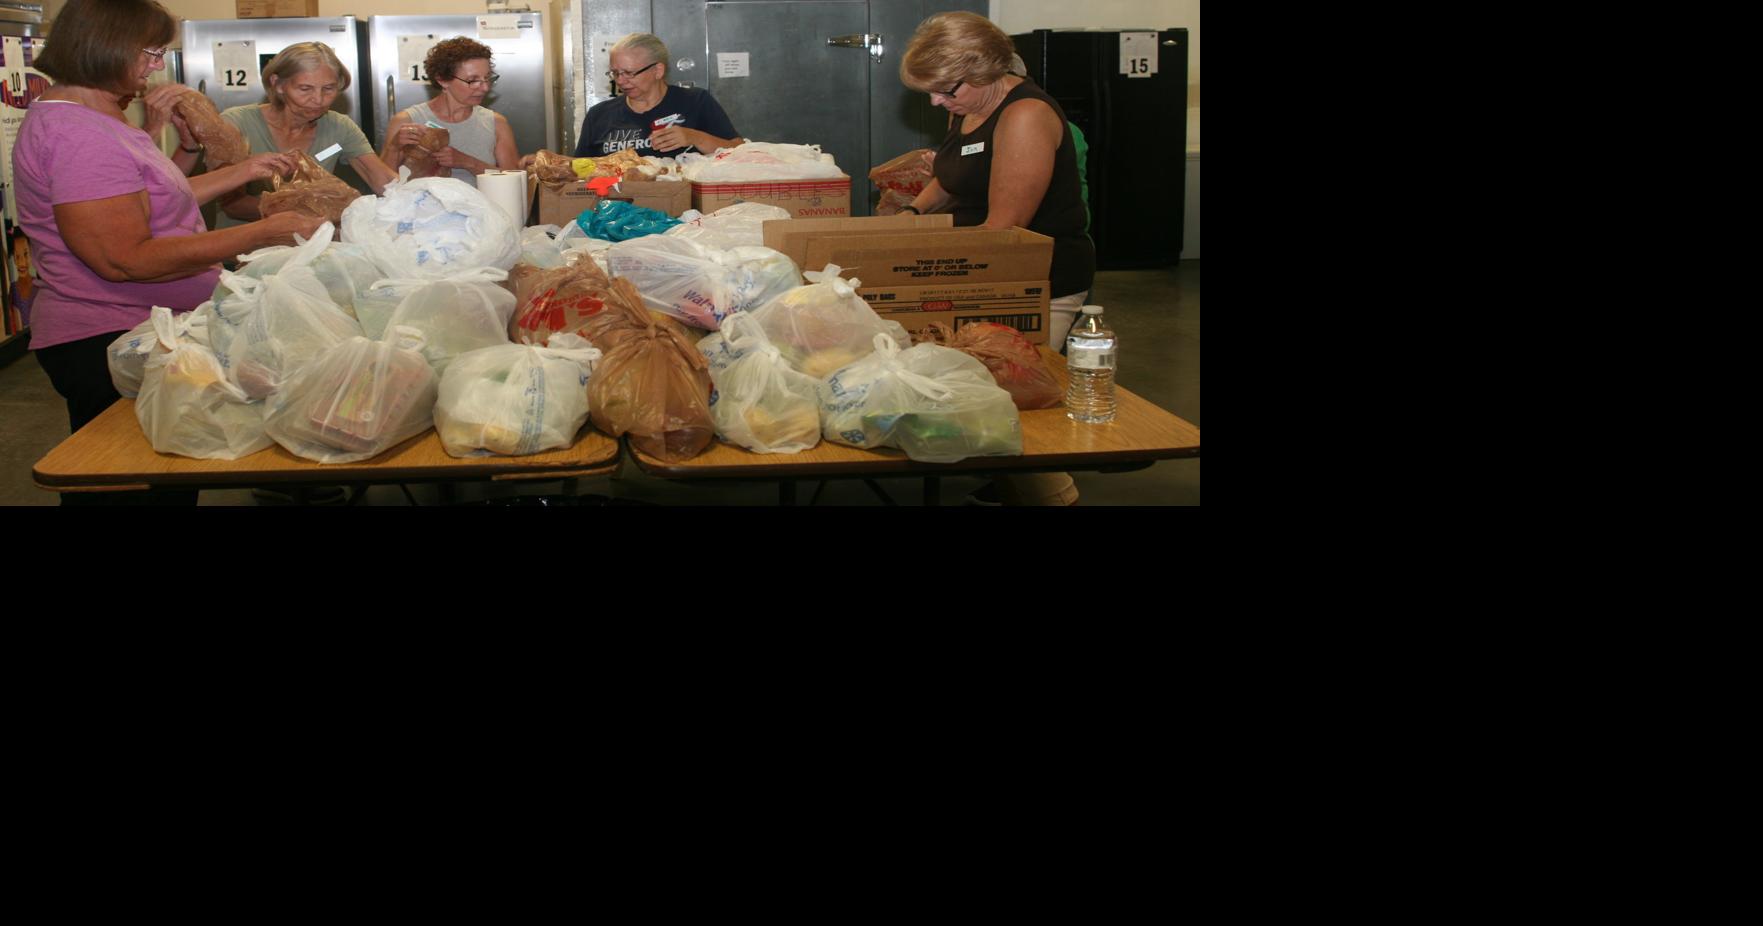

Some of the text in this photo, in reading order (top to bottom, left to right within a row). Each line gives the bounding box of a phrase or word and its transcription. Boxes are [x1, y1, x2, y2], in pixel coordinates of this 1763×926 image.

[1130, 58, 1148, 74] 15
[11, 71, 21, 92] 10
[225, 69, 247, 86] 12
[603, 138, 652, 154] GENERO
[798, 207, 846, 217] BANANAS
